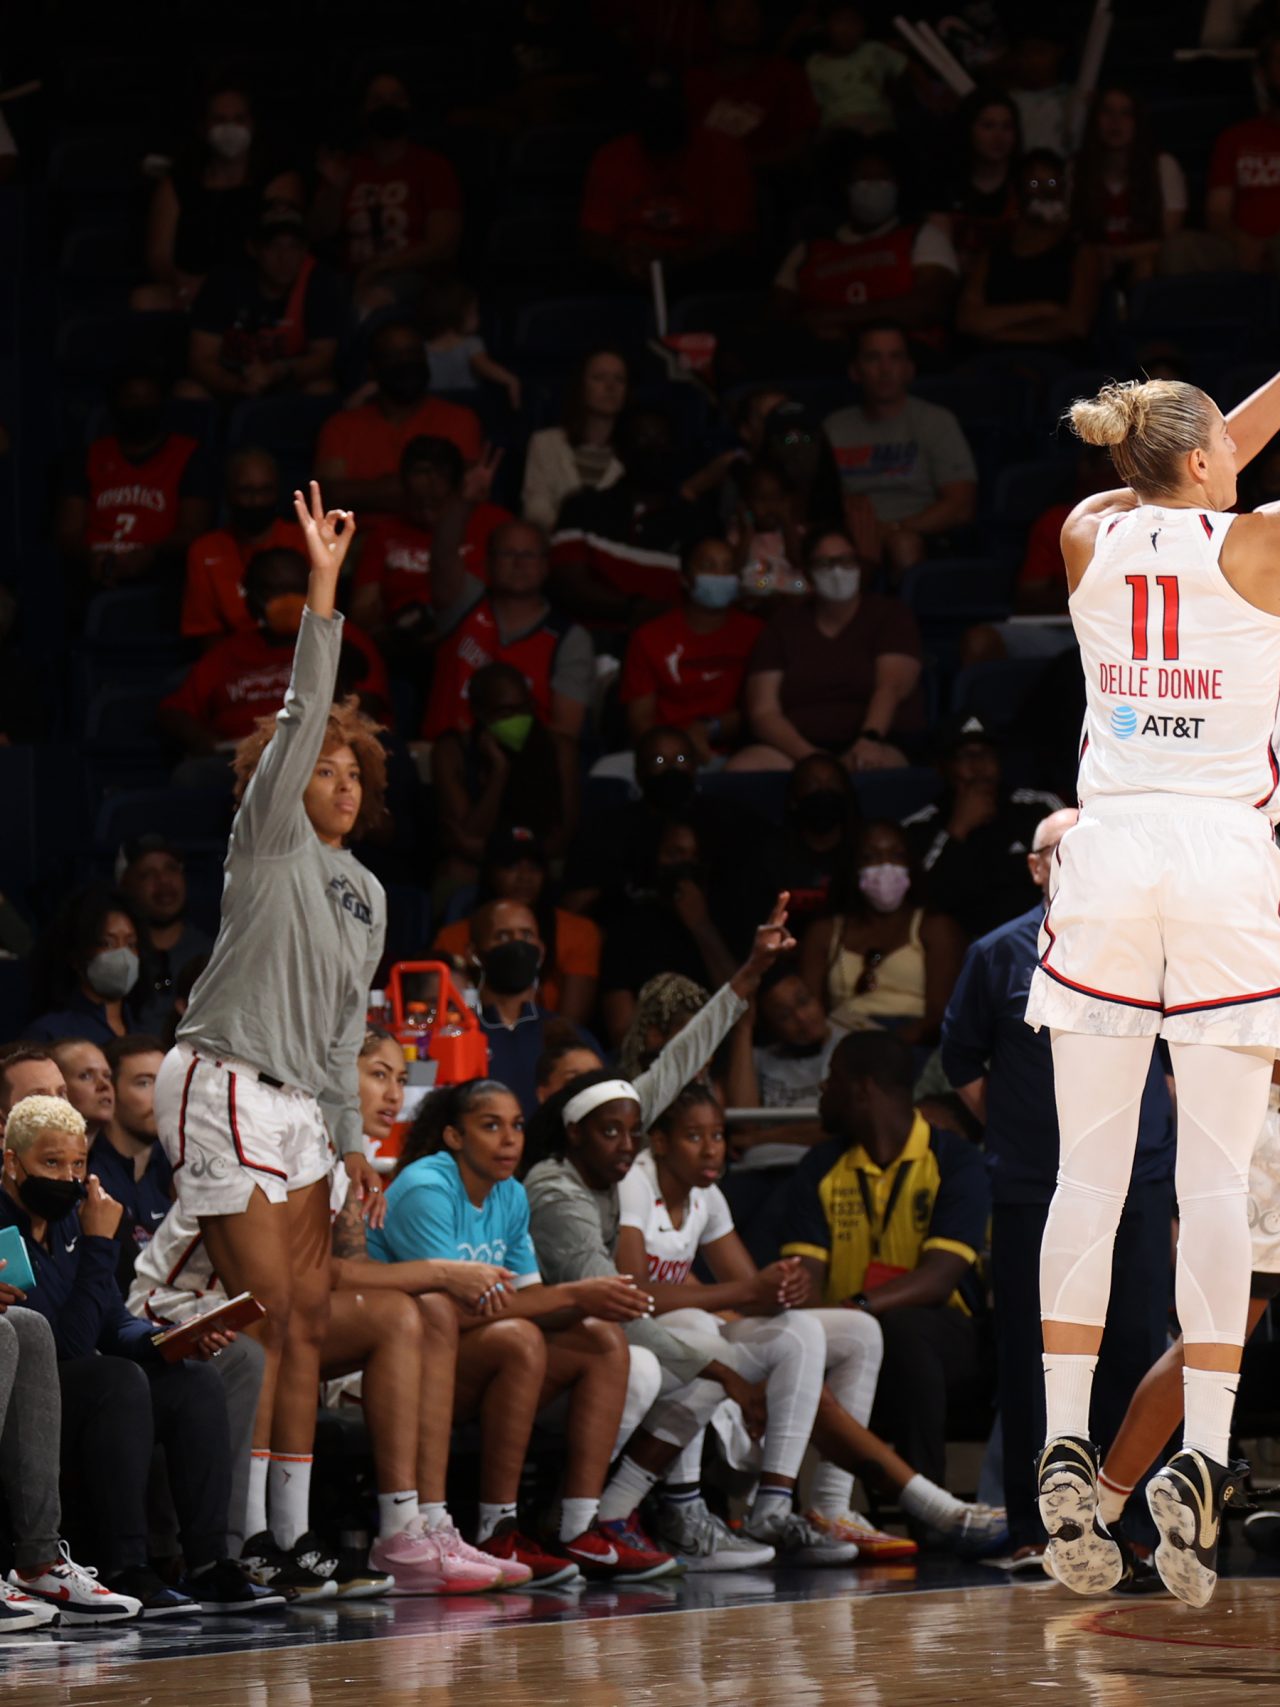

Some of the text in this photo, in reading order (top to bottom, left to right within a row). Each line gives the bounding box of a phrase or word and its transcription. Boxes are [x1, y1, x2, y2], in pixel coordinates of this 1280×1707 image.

[1125, 575, 1180, 661] 11
[1100, 663, 1223, 700] DELLE DONNE
[1141, 715, 1206, 739] AT&T
